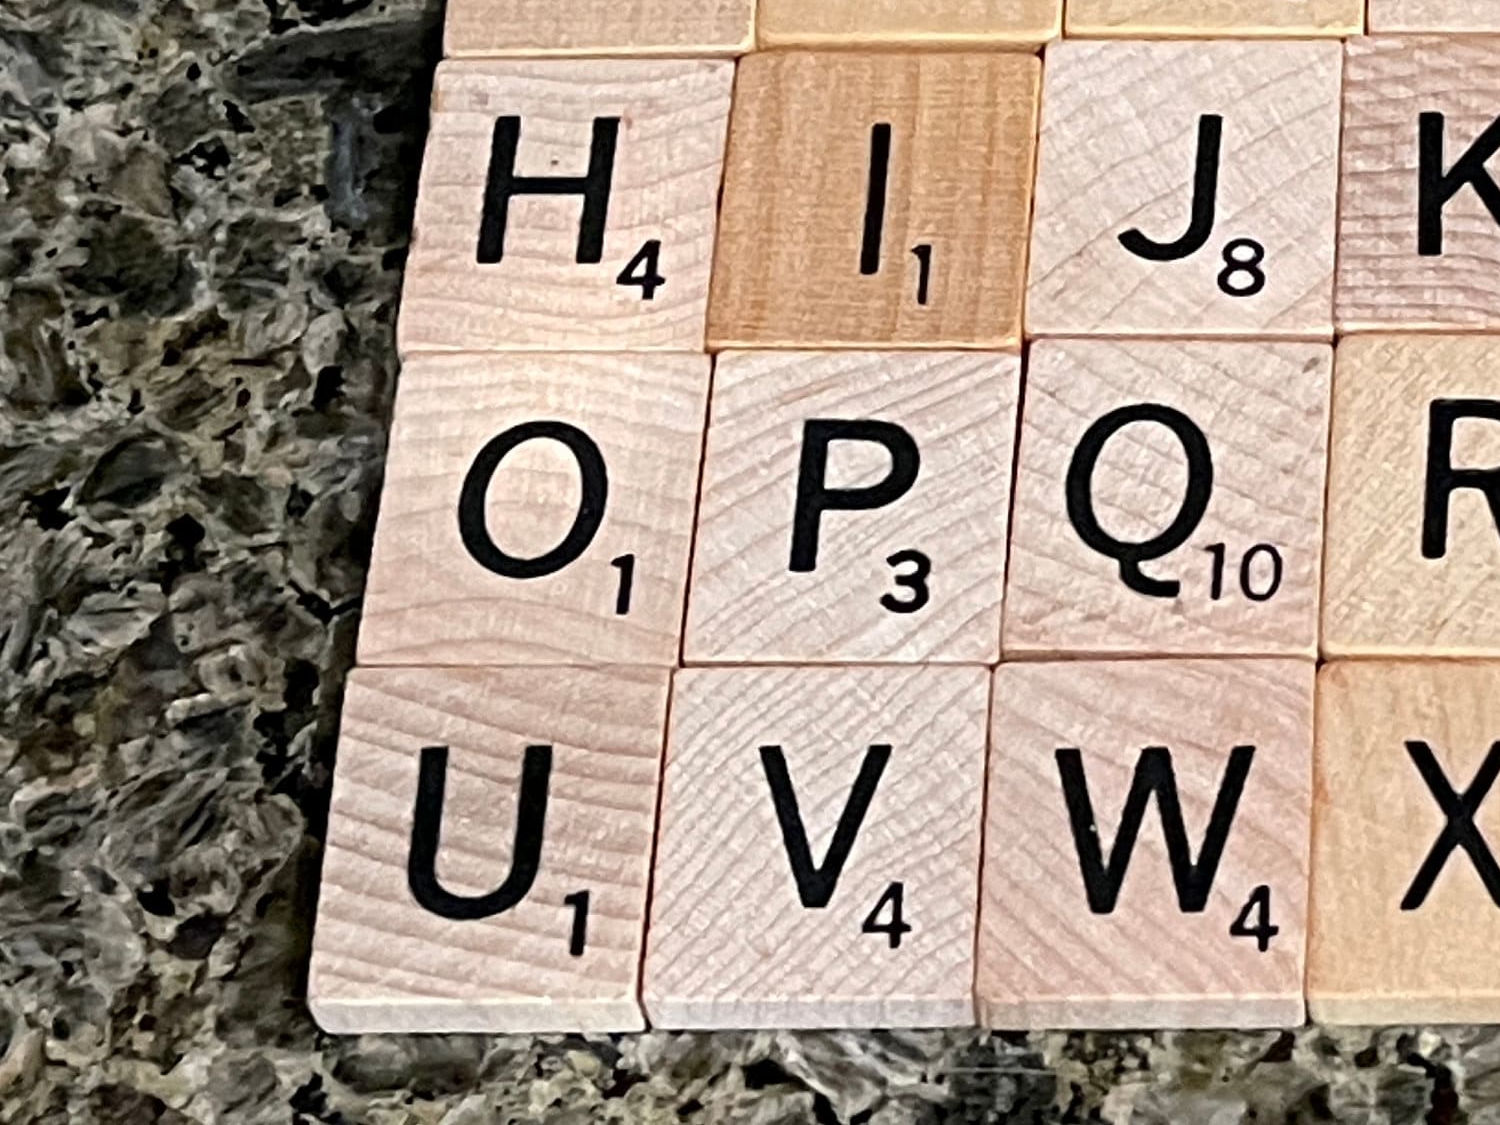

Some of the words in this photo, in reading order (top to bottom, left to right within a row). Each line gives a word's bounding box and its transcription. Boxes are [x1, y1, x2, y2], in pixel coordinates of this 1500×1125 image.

[476, 115, 621, 264] H
[616, 239, 666, 300] 4
[859, 122, 892, 276] I
[911, 244, 932, 305] 1
[1117, 114, 1223, 262] J
[1217, 238, 1266, 297] 8
[457, 420, 609, 580] O
[610, 553, 635, 615] 1
[788, 418, 921, 573] P
[879, 549, 932, 614] 3
[1065, 402, 1214, 598] Q
[1204, 542, 1283, 602] 10
[406, 744, 553, 922] U
[563, 889, 590, 957] 1
[758, 744, 893, 909] V
[861, 881, 912, 949] 4
[1054, 745, 1256, 915] W
[1229, 884, 1279, 953] 4
